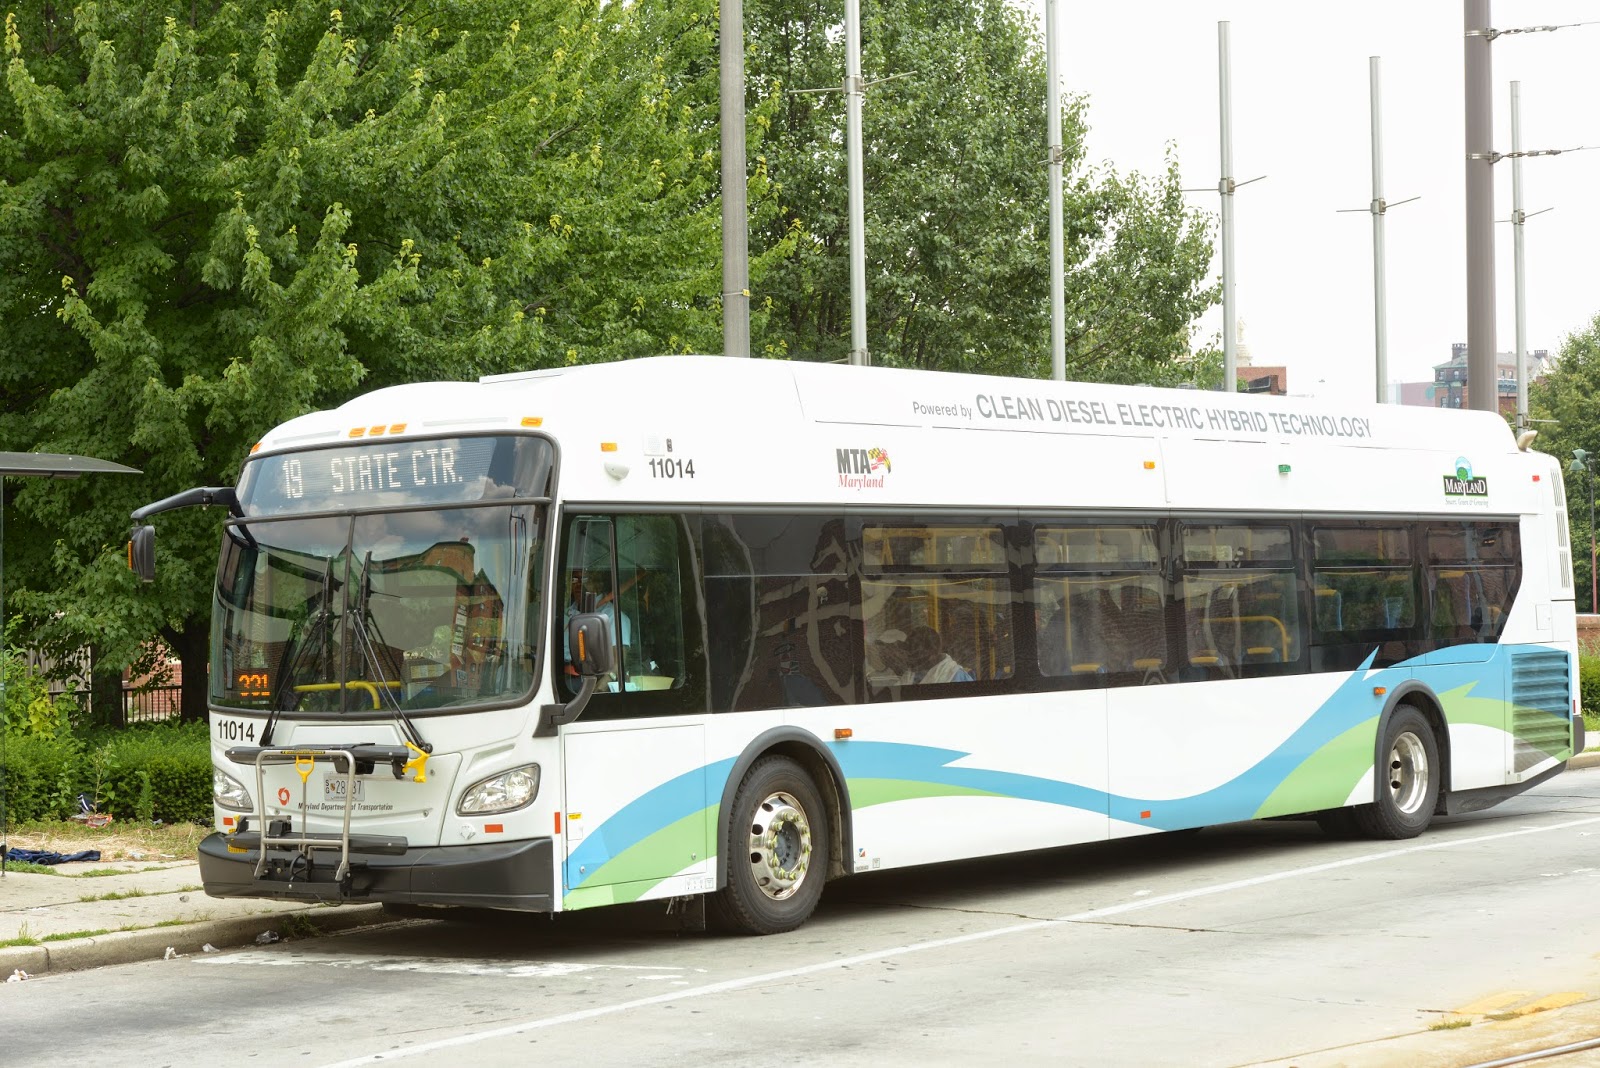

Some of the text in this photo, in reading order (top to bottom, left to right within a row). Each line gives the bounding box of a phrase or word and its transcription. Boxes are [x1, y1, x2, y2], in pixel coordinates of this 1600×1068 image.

[912, 393, 1372, 438] Powered by CLEAN DIESEL ELECTRIC HYBRID TECHNOLOGY
[649, 457, 695, 479] 11014
[836, 448, 871, 474] MTA
[282, 447, 463, 499] 19 STATE CTR.
[838, 474, 883, 491] Maryland
[218, 719, 255, 742] 11014
[298, 802, 321, 811] Mryland
[321, 802, 346, 812] Departmen
[358, 802, 393, 812] Transportation
